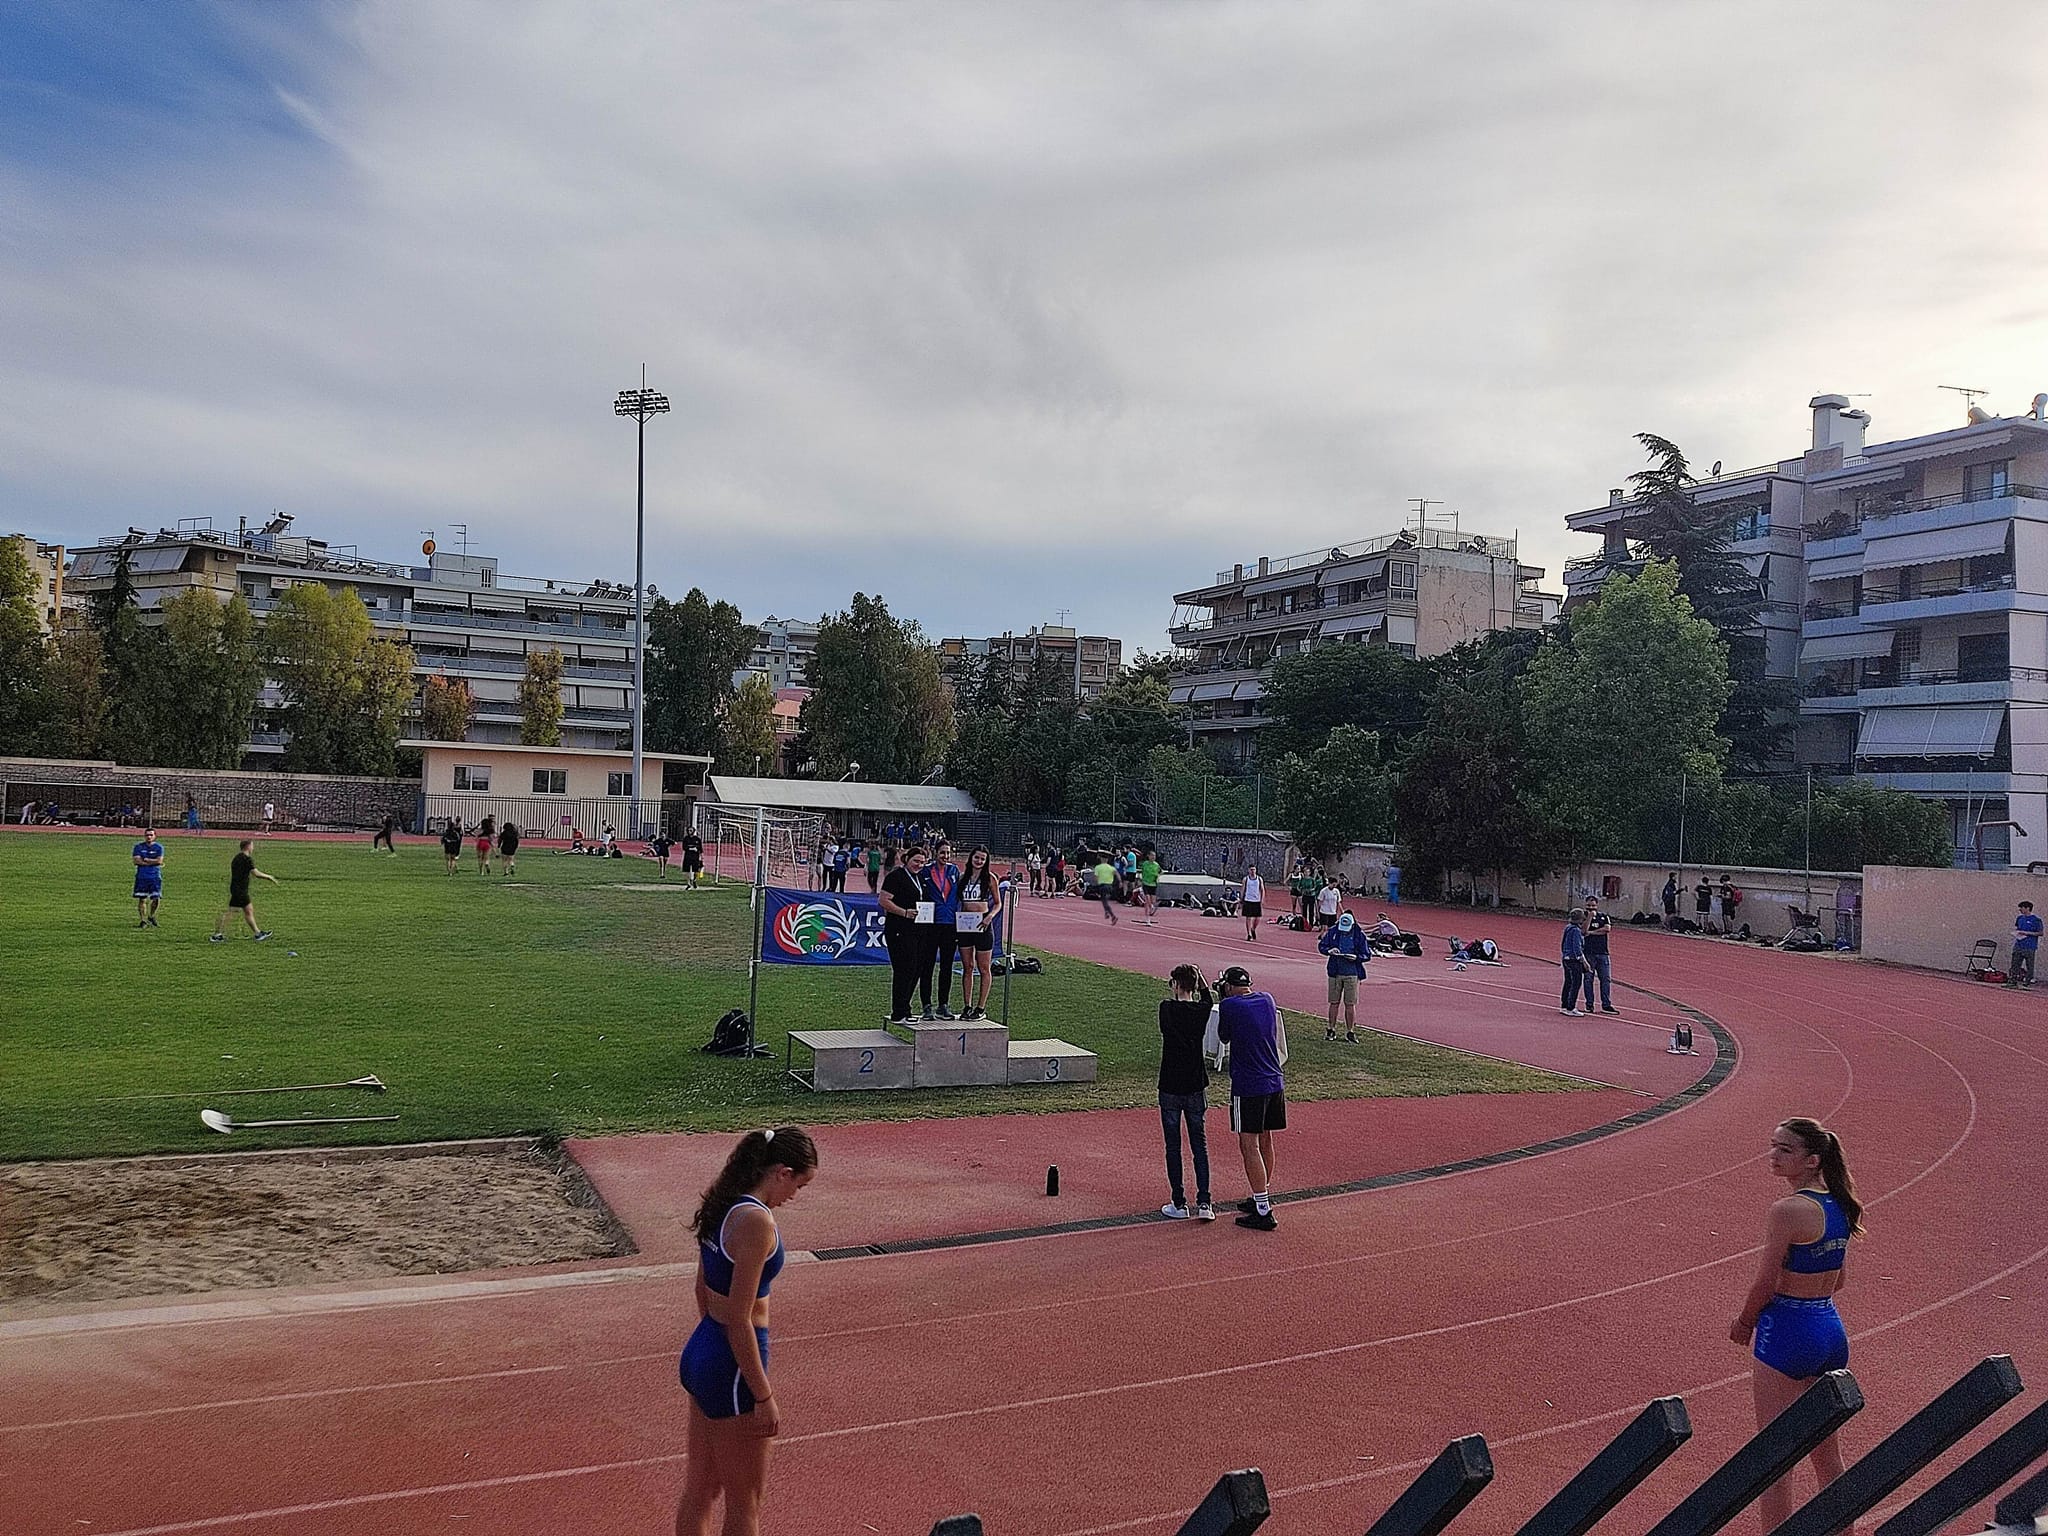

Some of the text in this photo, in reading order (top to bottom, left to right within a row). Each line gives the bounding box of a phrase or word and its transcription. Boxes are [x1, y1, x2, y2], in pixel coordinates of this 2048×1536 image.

[810, 944, 834, 953] 1996
[957, 1032, 966, 1055] 1
[859, 1050, 874, 1073] 2
[1045, 1058, 1060, 1081] 3
